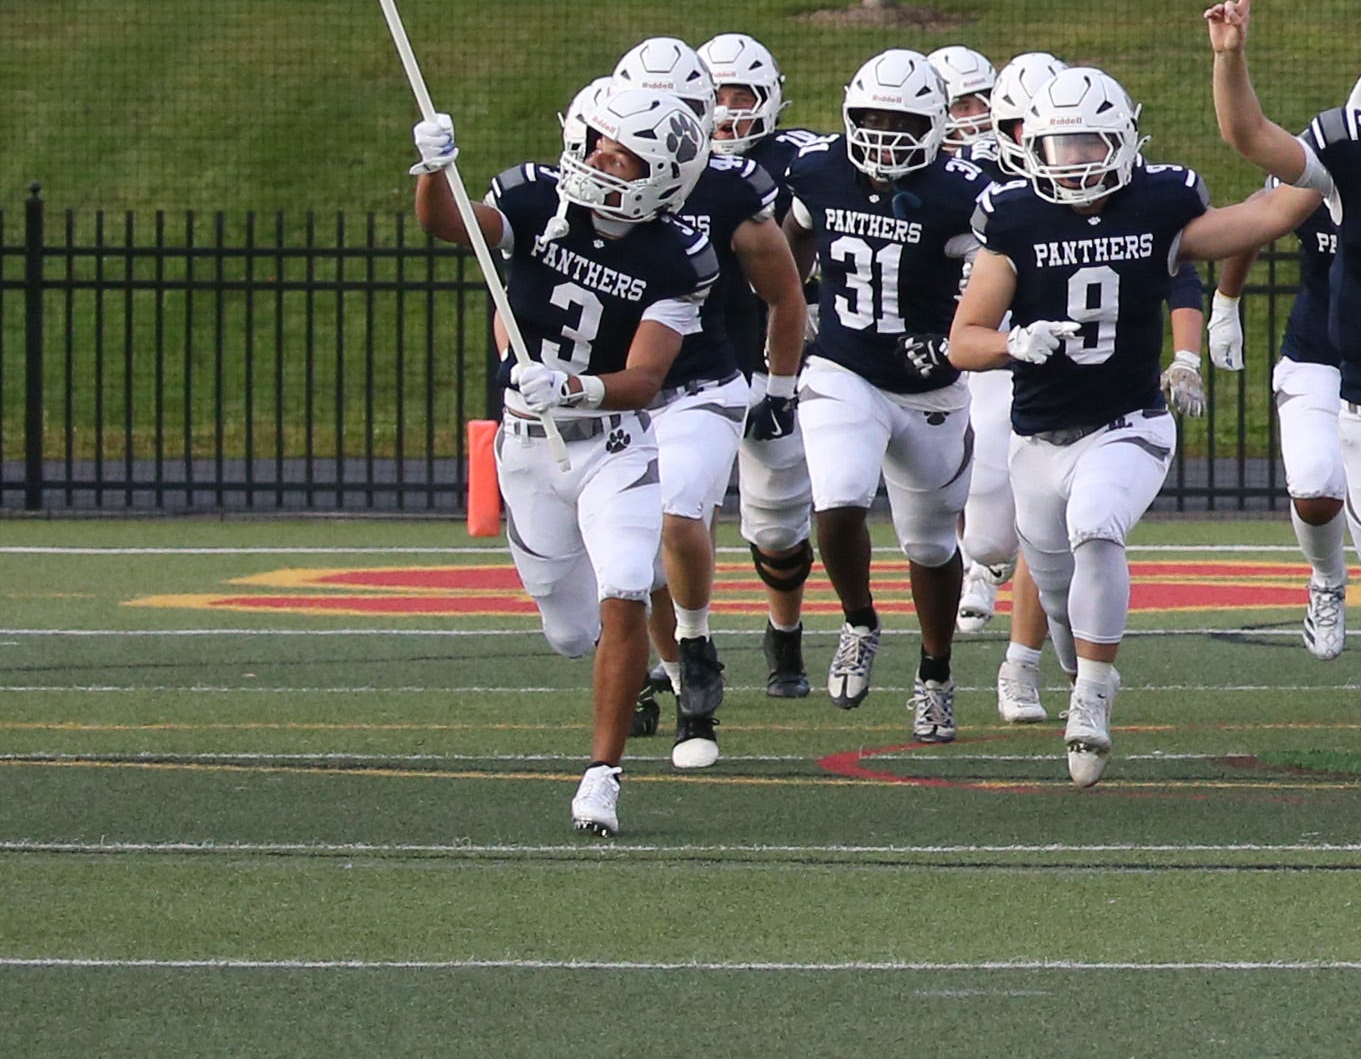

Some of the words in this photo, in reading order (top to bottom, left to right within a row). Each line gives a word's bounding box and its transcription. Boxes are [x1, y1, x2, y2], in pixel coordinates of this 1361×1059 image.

[825, 208, 922, 244] PANTHERS
[1033, 233, 1154, 268] PANTHERS
[531, 235, 647, 301] PANTHERS
[830, 235, 906, 334] 31
[541, 282, 604, 374] 3
[1065, 265, 1120, 365] 9
